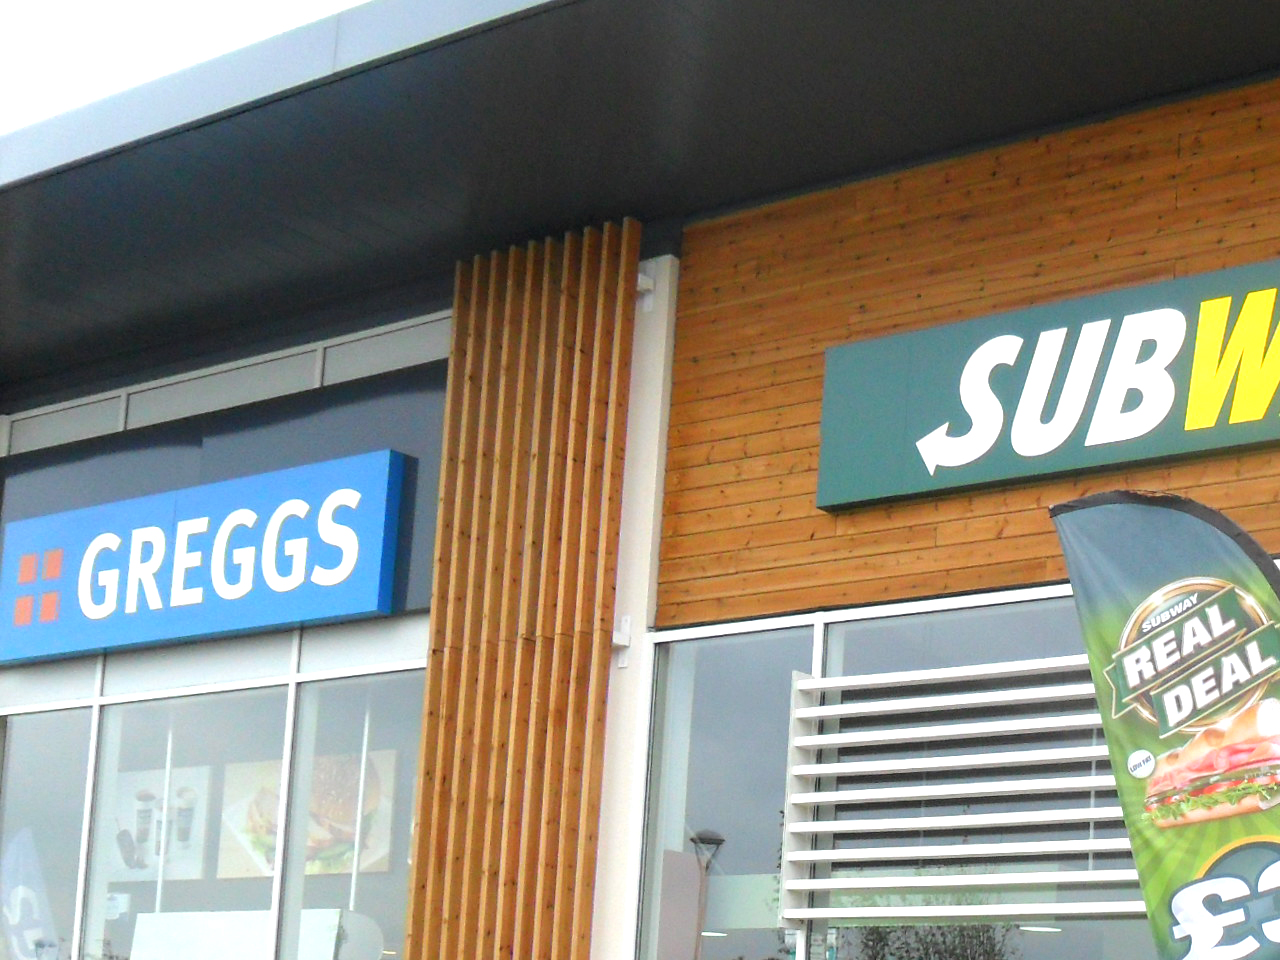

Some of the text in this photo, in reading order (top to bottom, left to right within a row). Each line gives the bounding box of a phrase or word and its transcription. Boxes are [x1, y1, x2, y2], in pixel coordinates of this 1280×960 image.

[78, 488, 361, 620] GREGGS
[1123, 605, 1236, 689] REAL
[1141, 592, 1199, 633] SUBWAY
[1161, 641, 1277, 728] DEAL
